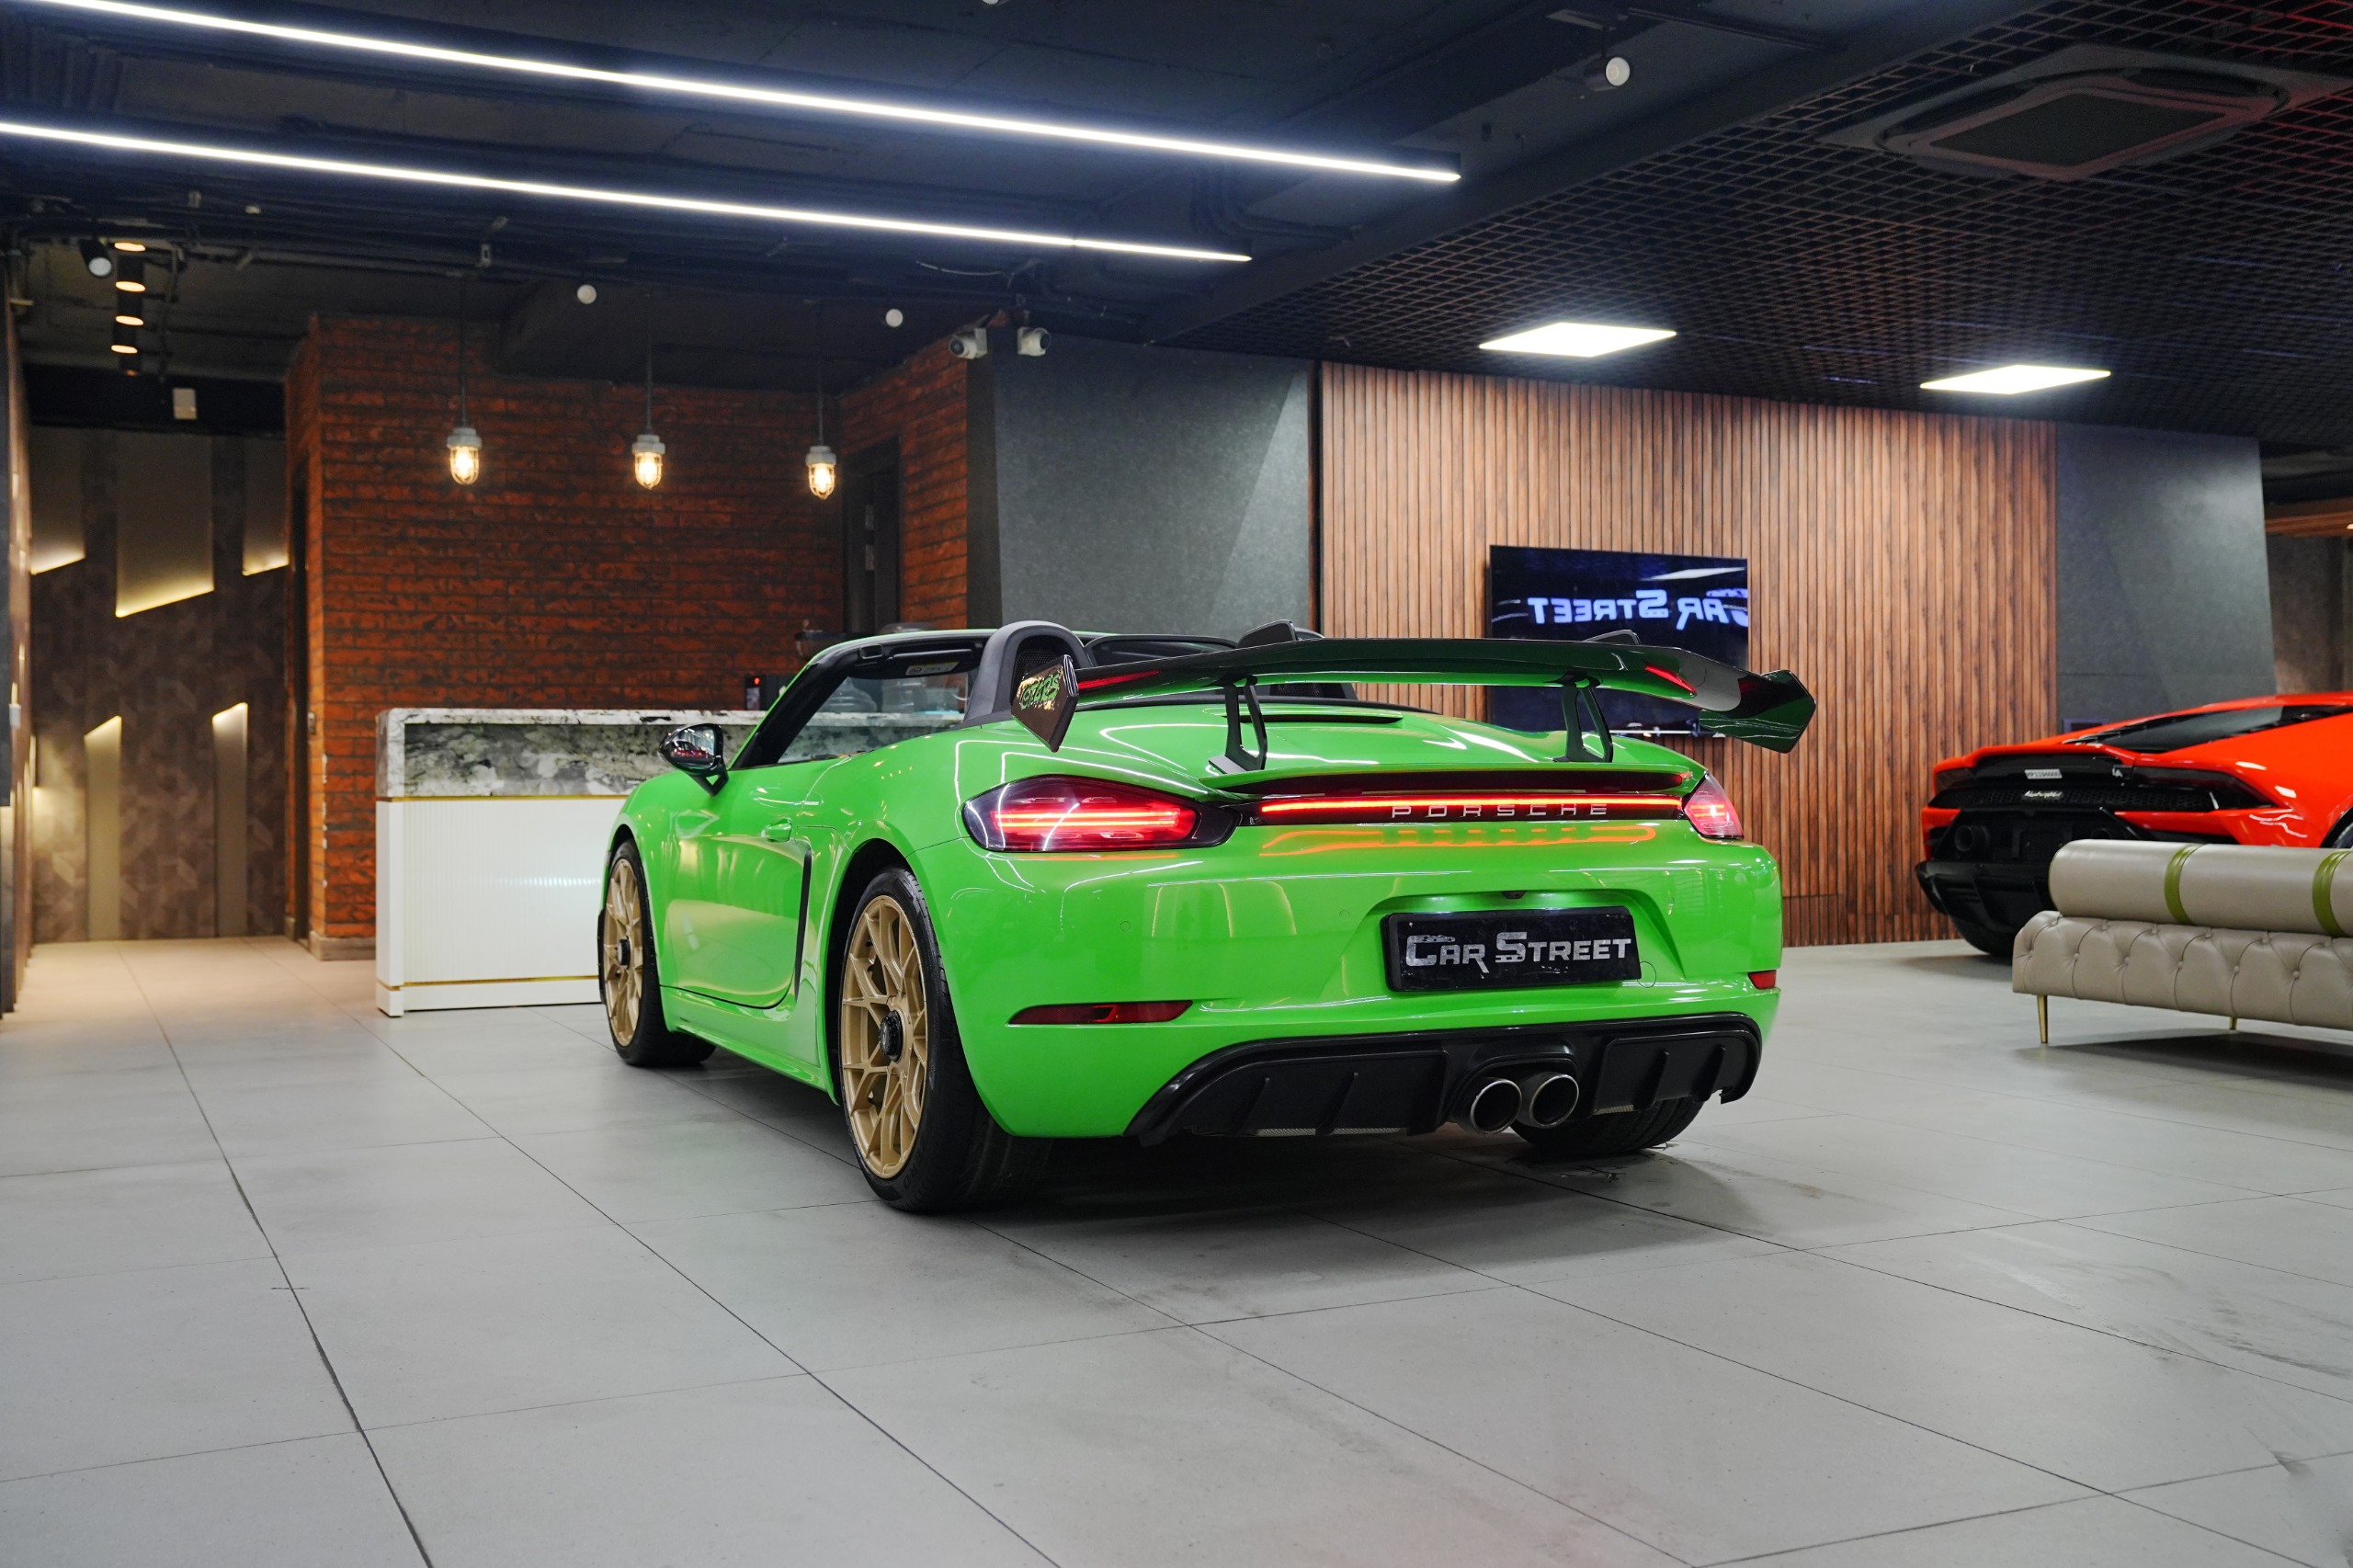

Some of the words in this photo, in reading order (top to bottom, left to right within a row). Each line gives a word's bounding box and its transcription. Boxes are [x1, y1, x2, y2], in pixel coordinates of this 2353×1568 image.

[1391, 803, 1608, 818] PORSCHE
[1405, 934, 1489, 973] CAR
[1495, 931, 1631, 963] STREET
